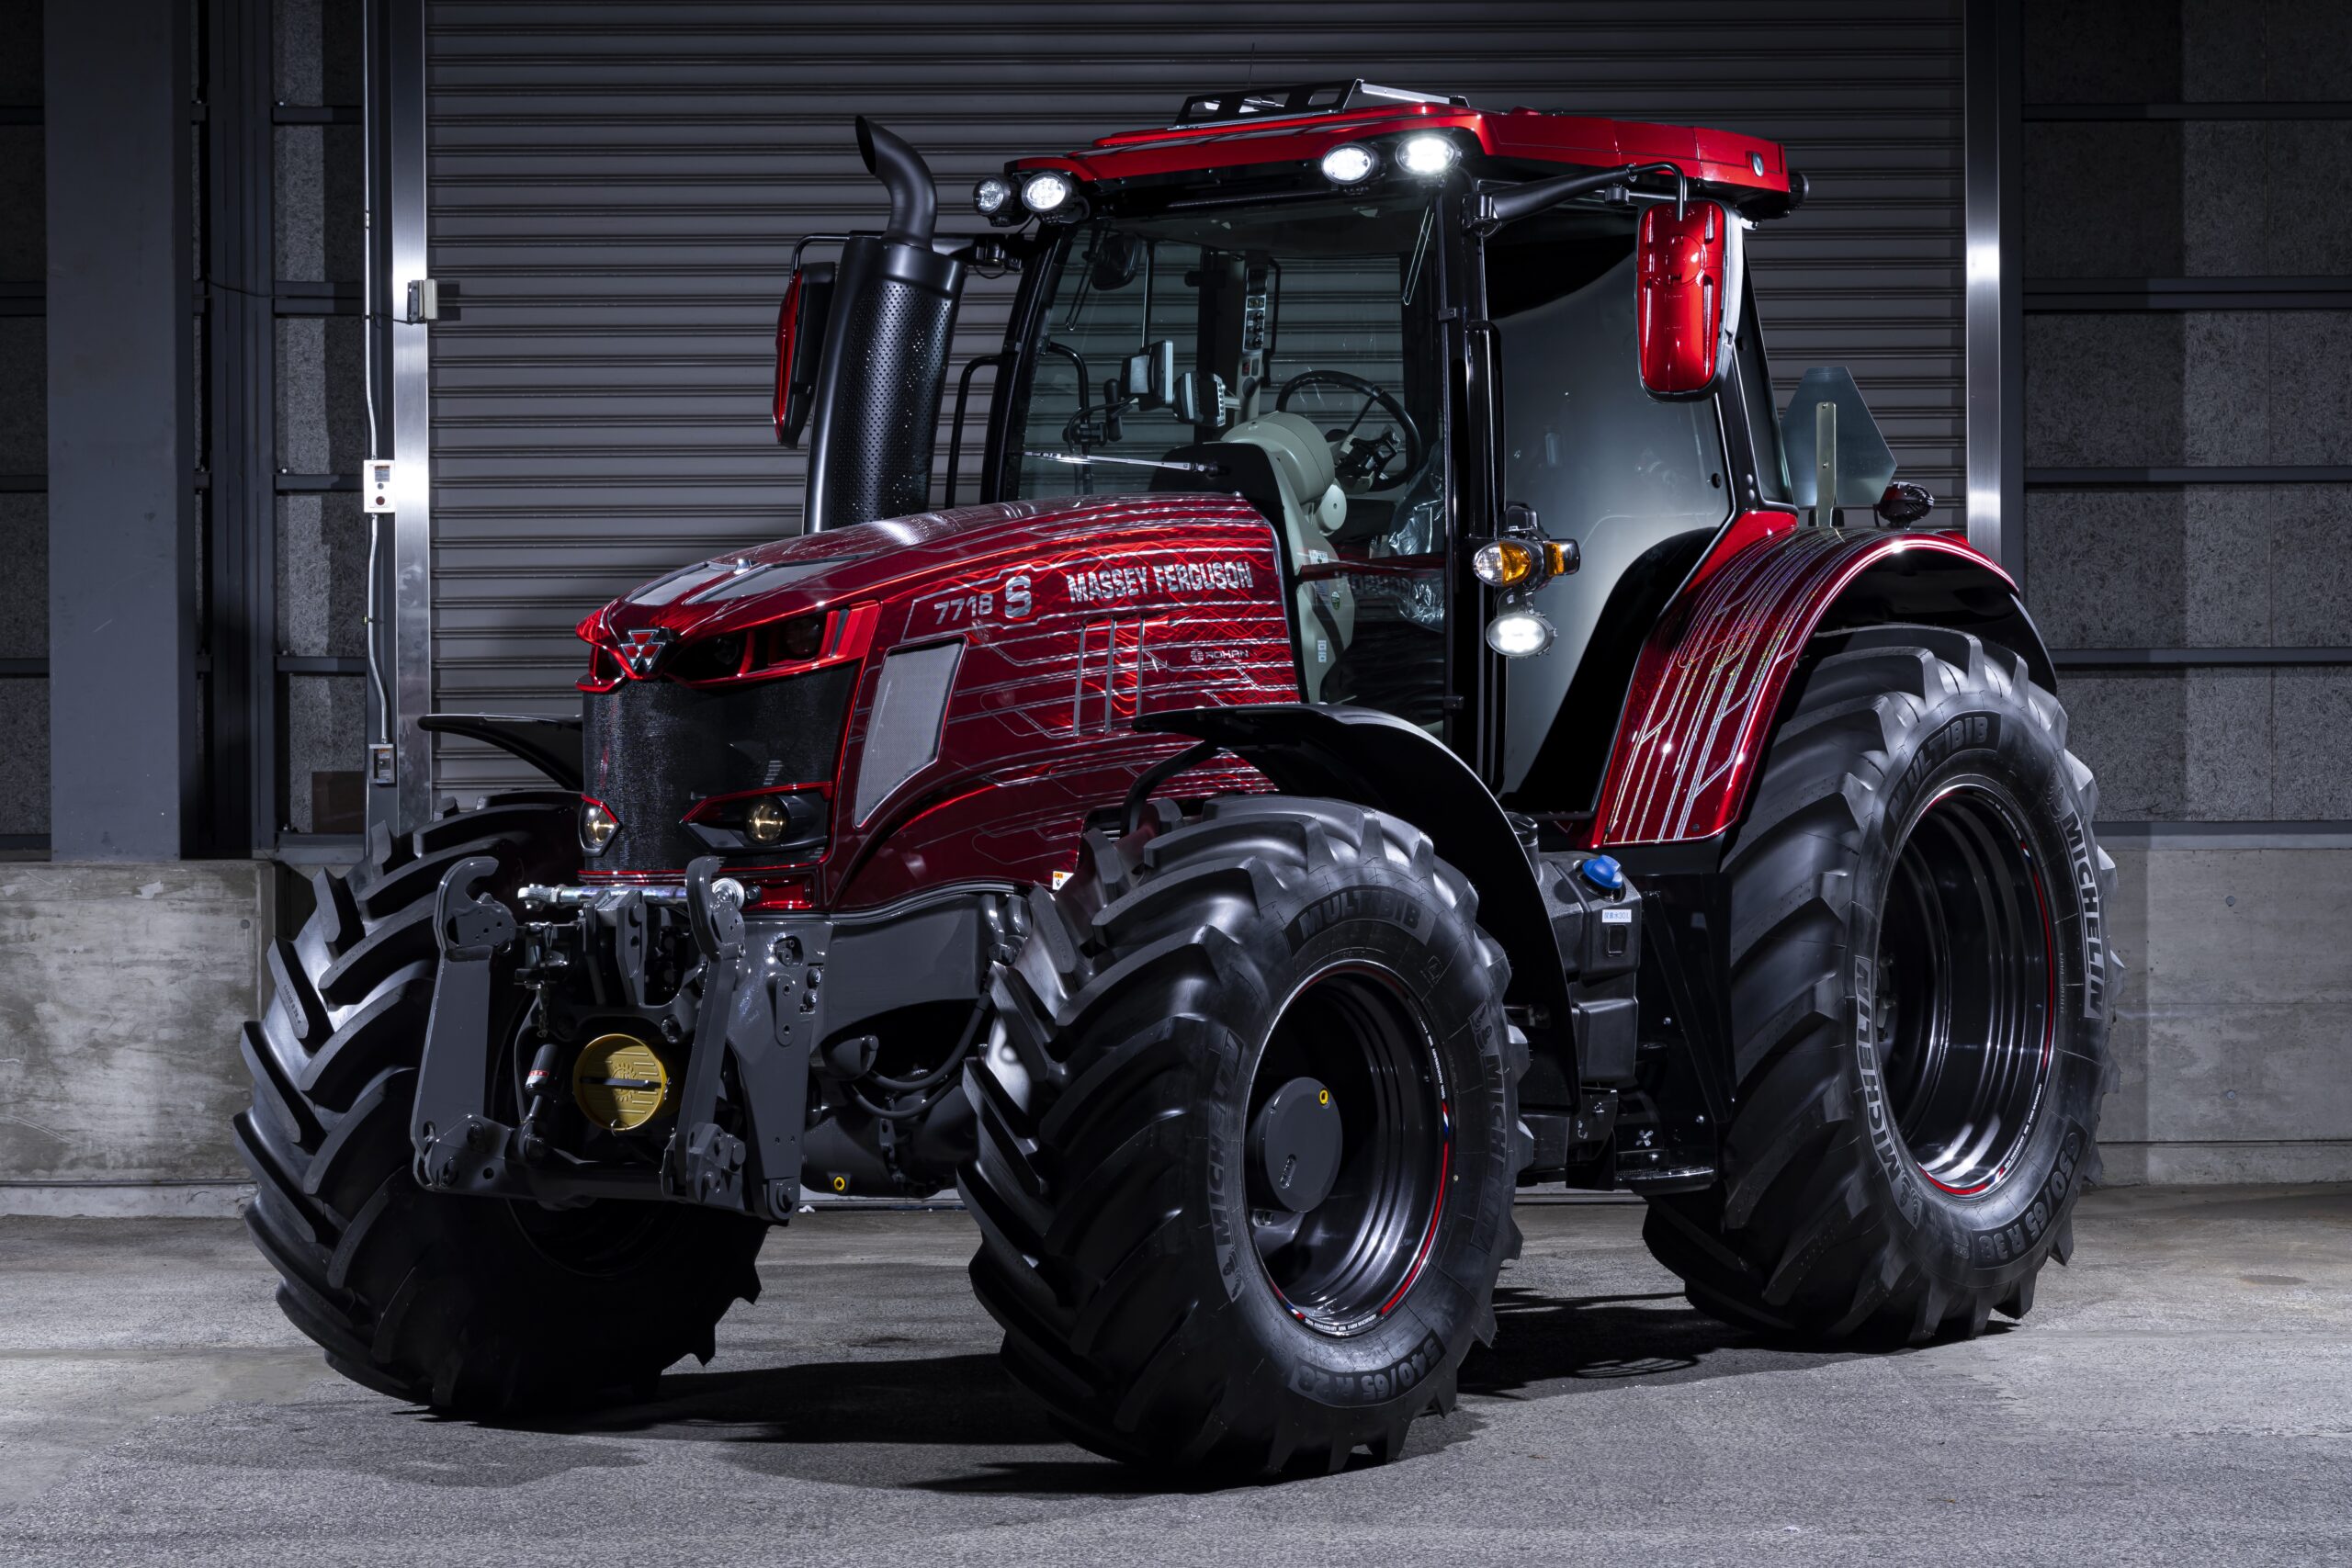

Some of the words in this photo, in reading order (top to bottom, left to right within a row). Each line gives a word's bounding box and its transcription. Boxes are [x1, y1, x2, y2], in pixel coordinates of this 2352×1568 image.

[933, 592, 994, 625] 7718
[1003, 575, 1032, 618] S
[1066, 567, 1149, 604] MASSEY
[1154, 560, 1254, 594] FERGUSON
[1298, 889, 1422, 941] MULTIBIB
[2065, 816, 2105, 1017] MICHELIN
[1855, 959, 1902, 1182] MICHELIN
[1209, 1029, 1243, 1247] MICHELIN
[2025, 1132, 2080, 1241] 650/65
[1978, 1233, 2008, 1260] 38
[2007, 1224, 2026, 1255] R
[1296, 1365, 1330, 1400] 28
[1336, 1376, 1355, 1397] R
[1361, 1337, 1442, 1400] 540/65
